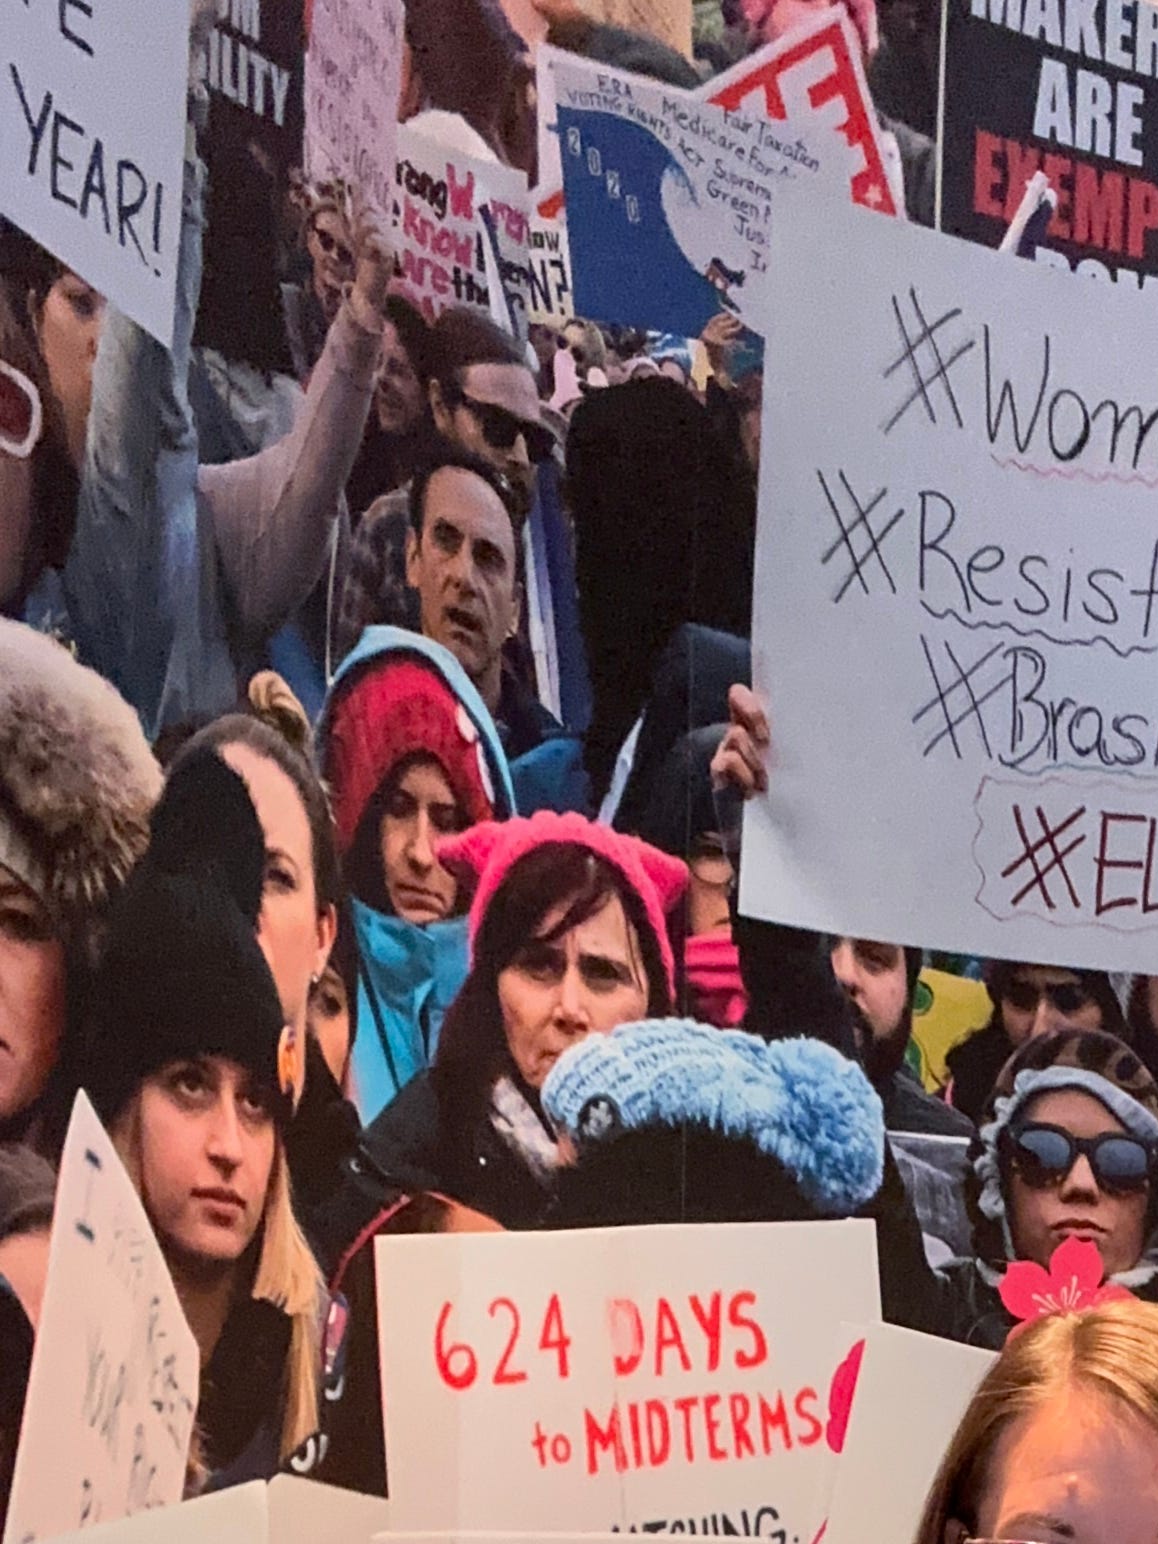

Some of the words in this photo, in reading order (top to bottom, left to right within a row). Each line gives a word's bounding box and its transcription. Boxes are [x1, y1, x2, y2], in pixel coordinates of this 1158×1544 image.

[208, 28, 290, 127] ILITY
[597, 74, 633, 99] ERA
[1033, 57, 1144, 167] ARE
[9, 62, 161, 278] YEAR!
[435, 1292, 571, 1390] 624
[606, 1290, 768, 1377] DAYS
[531, 1421, 571, 1469] to
[583, 1386, 823, 1475] MIDTERMS
